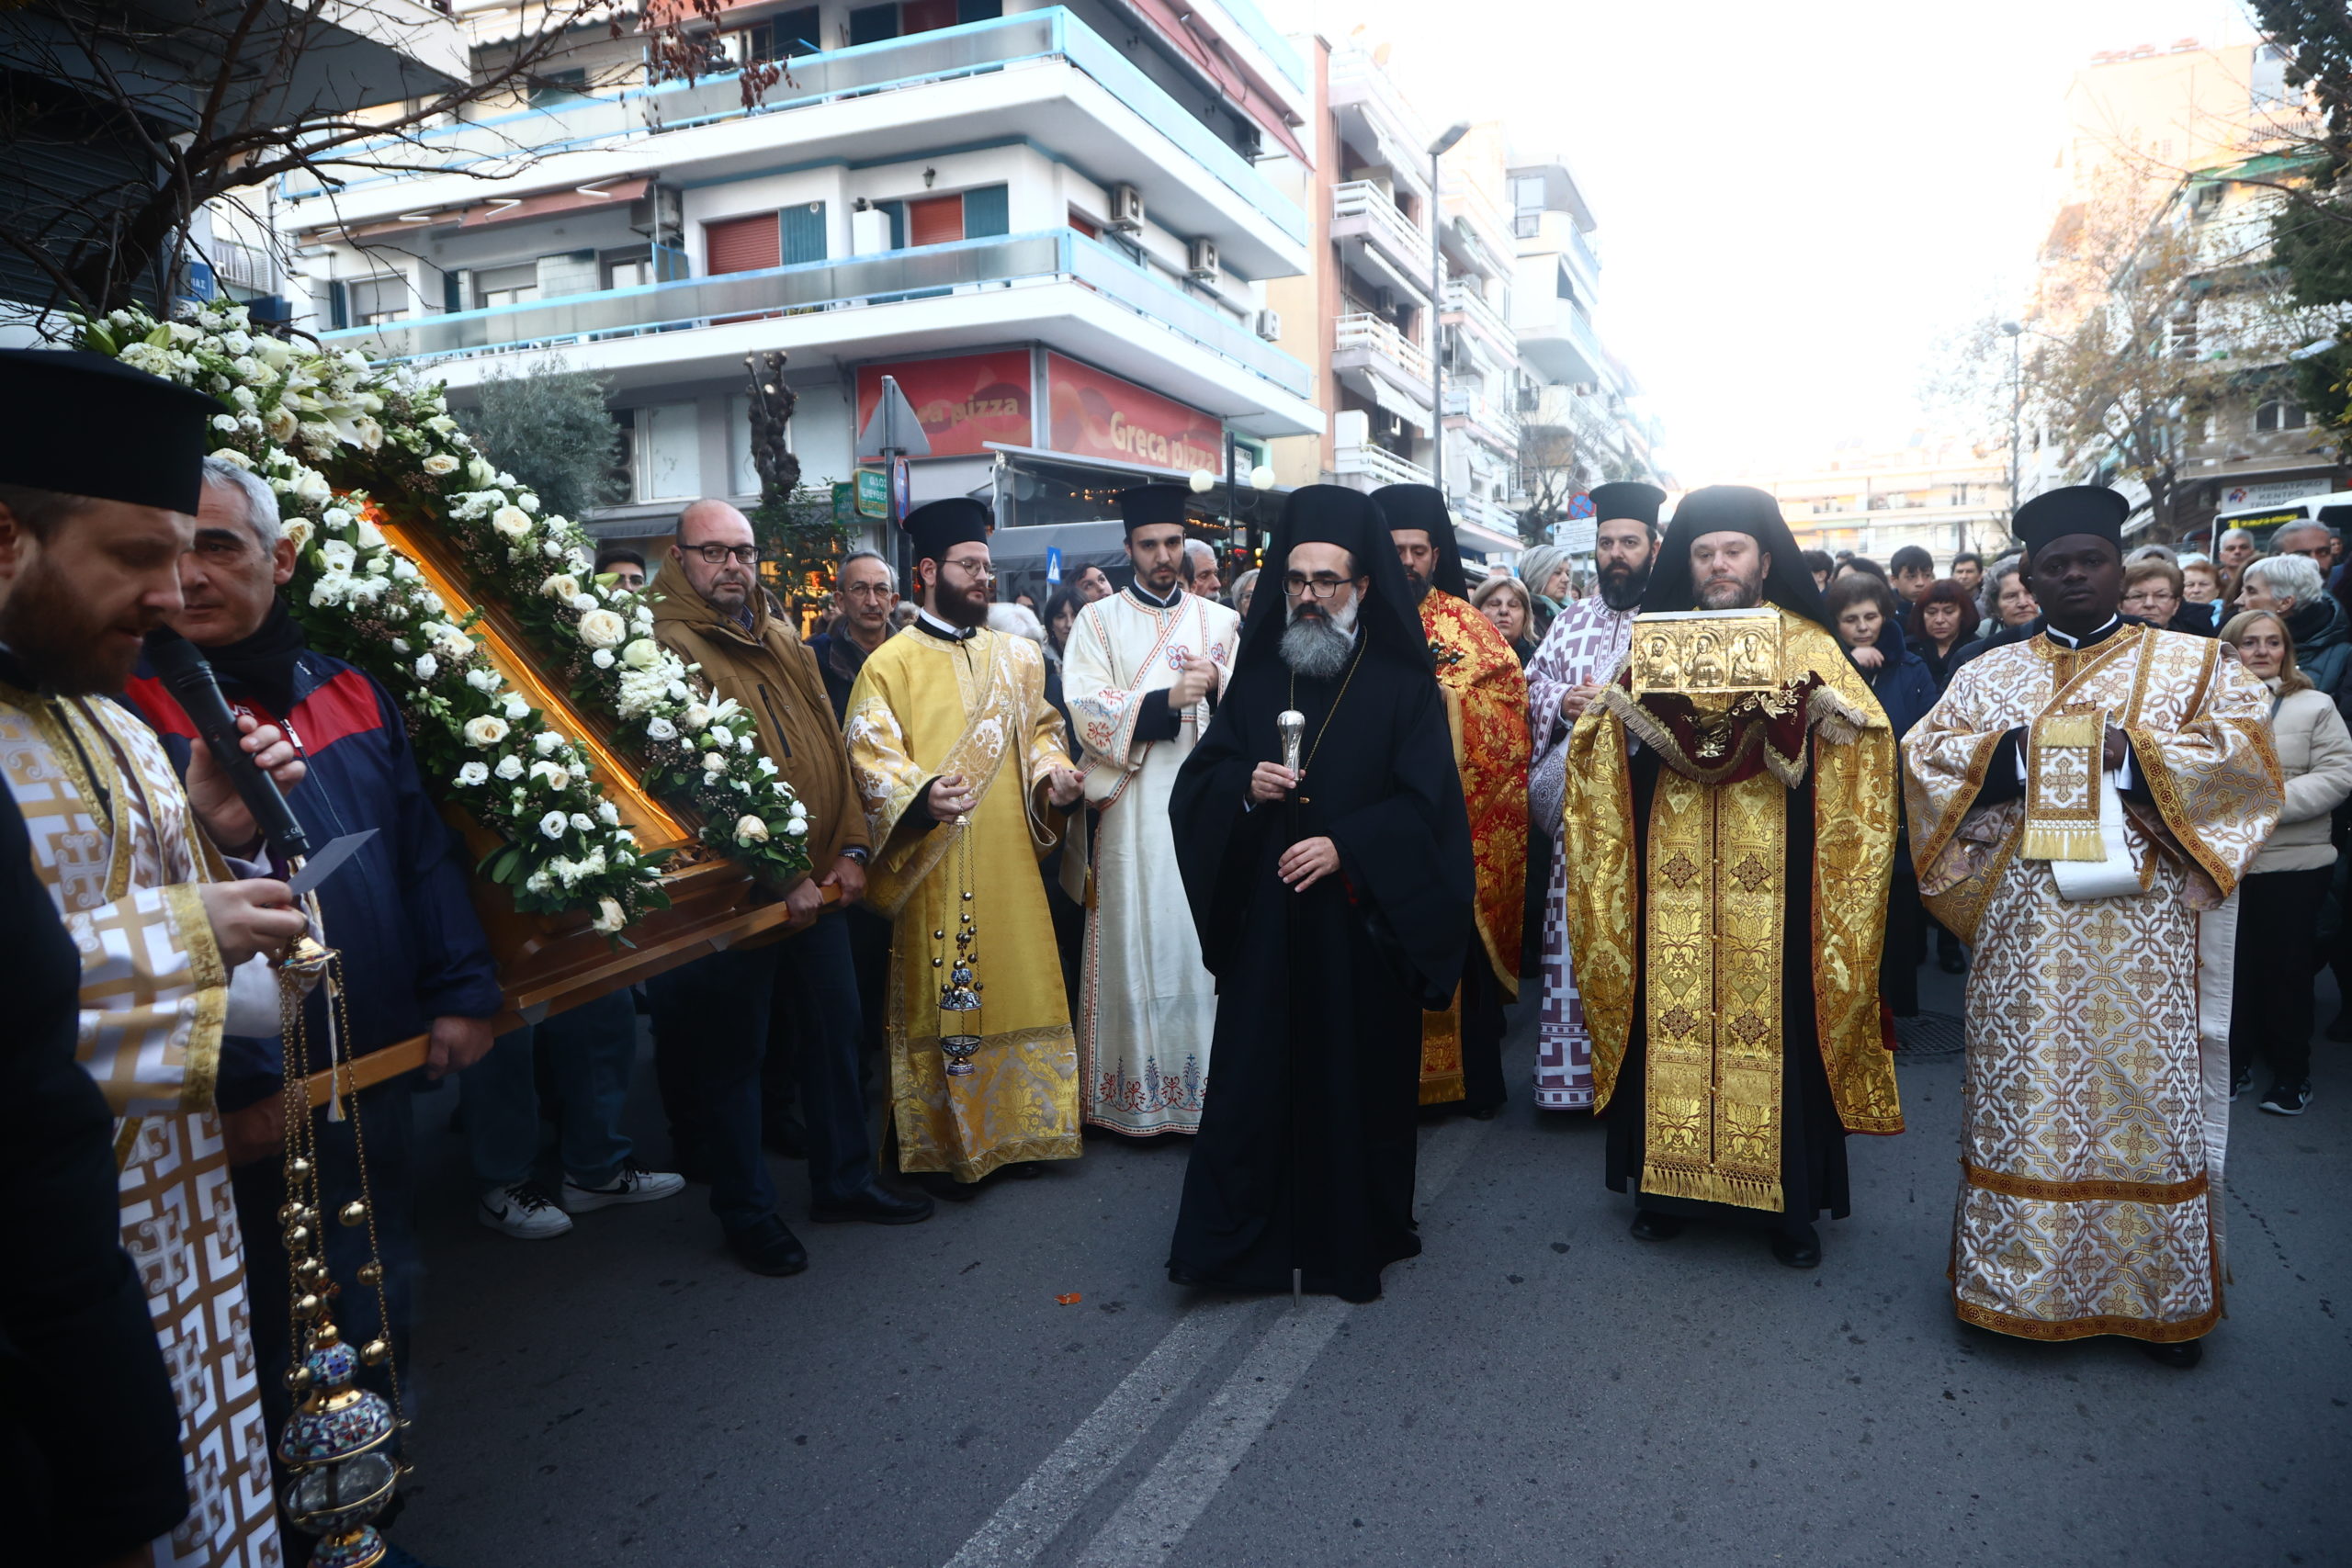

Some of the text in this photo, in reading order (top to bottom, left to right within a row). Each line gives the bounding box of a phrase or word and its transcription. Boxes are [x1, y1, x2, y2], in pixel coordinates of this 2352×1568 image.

[951, 395, 1017, 426] pizza
[1110, 412, 1216, 473] Greca pizza
[2258, 489, 2304, 501] ΚΕΝΤΡΟ
